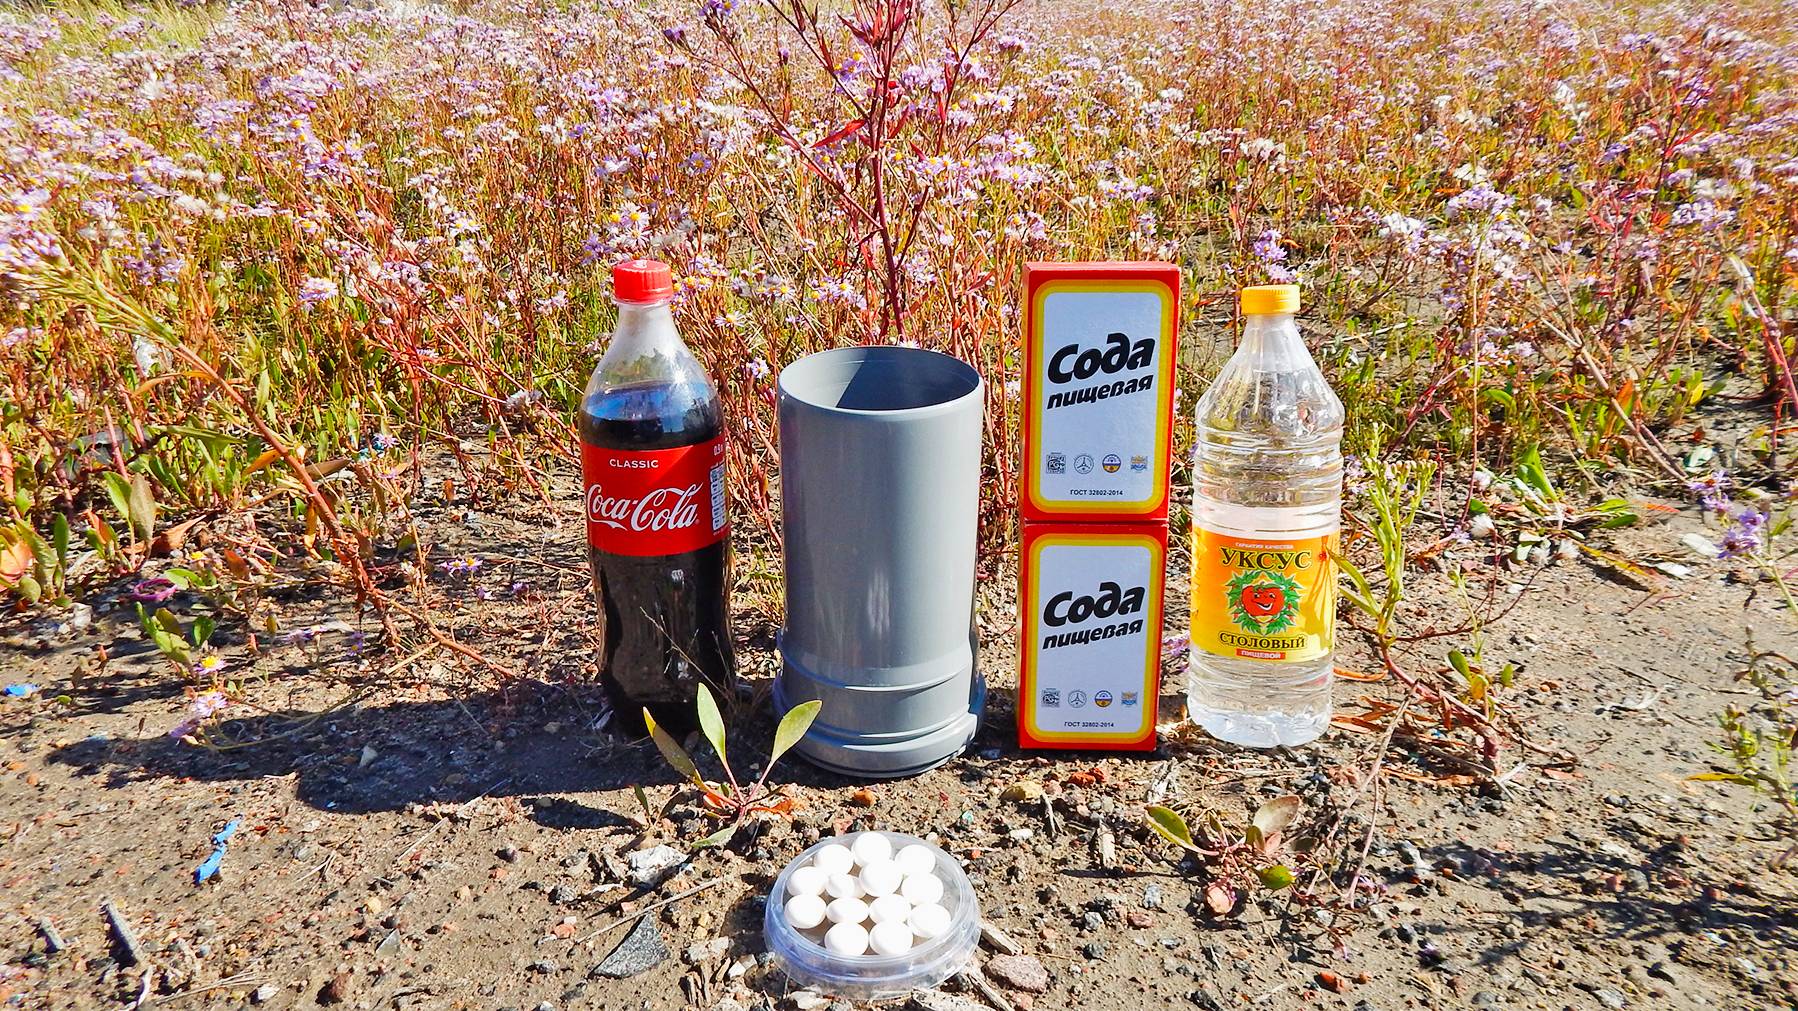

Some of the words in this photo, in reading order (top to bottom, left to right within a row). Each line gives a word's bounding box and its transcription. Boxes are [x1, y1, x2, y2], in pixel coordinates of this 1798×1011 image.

[1047, 333, 1156, 384] Сода
[1047, 375, 1154, 410] пищевая
[609, 458, 659, 469] CLASSIC
[587, 482, 704, 532] Coca-Cola
[1220, 547, 1312, 570] УКСУС
[1043, 581, 1146, 627] Сода
[1042, 619, 1144, 650] пищевая
[1219, 632, 1305, 649] СТОЛОВЫЙ
